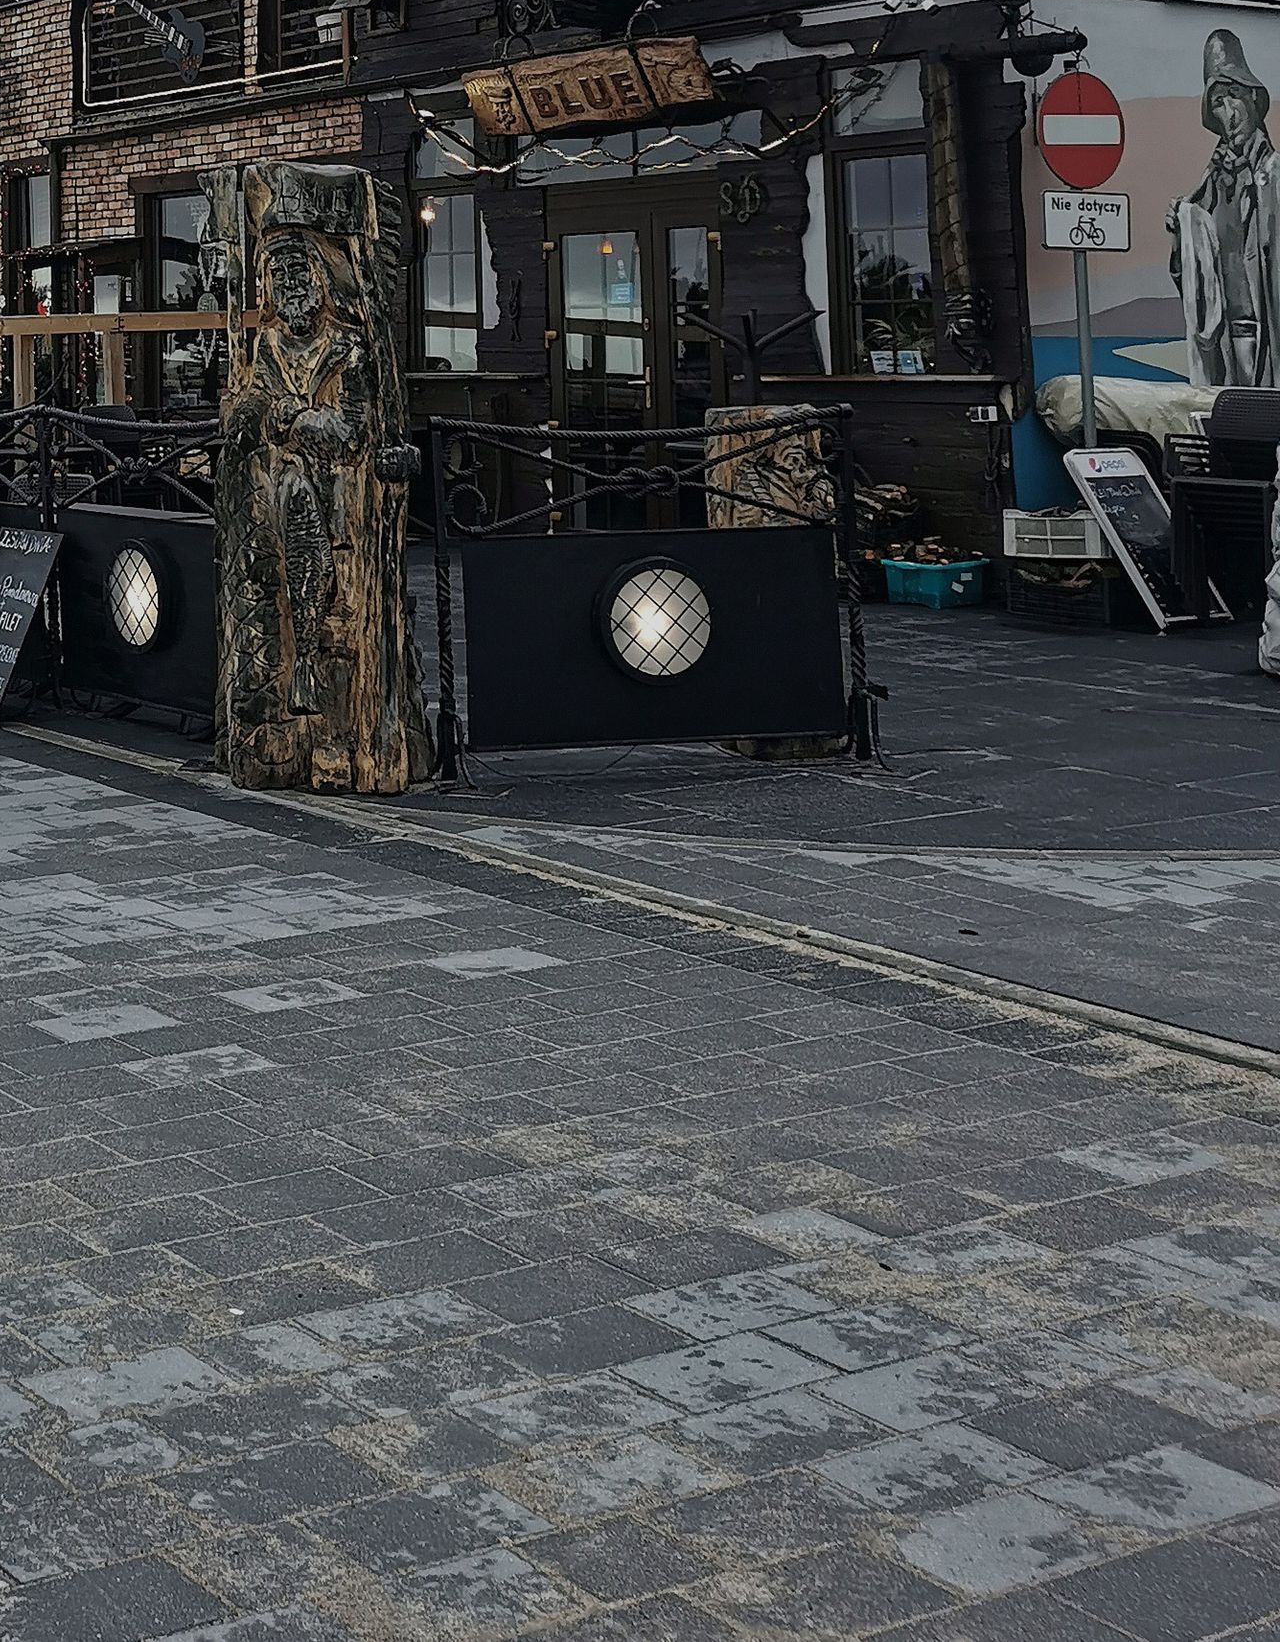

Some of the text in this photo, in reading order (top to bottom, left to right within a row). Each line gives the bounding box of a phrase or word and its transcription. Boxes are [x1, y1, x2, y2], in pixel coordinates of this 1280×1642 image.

[529, 70, 642, 117] BLUE
[1051, 196, 1121, 216] Nie dotyczy
[1101, 459, 1127, 471] pepsi
